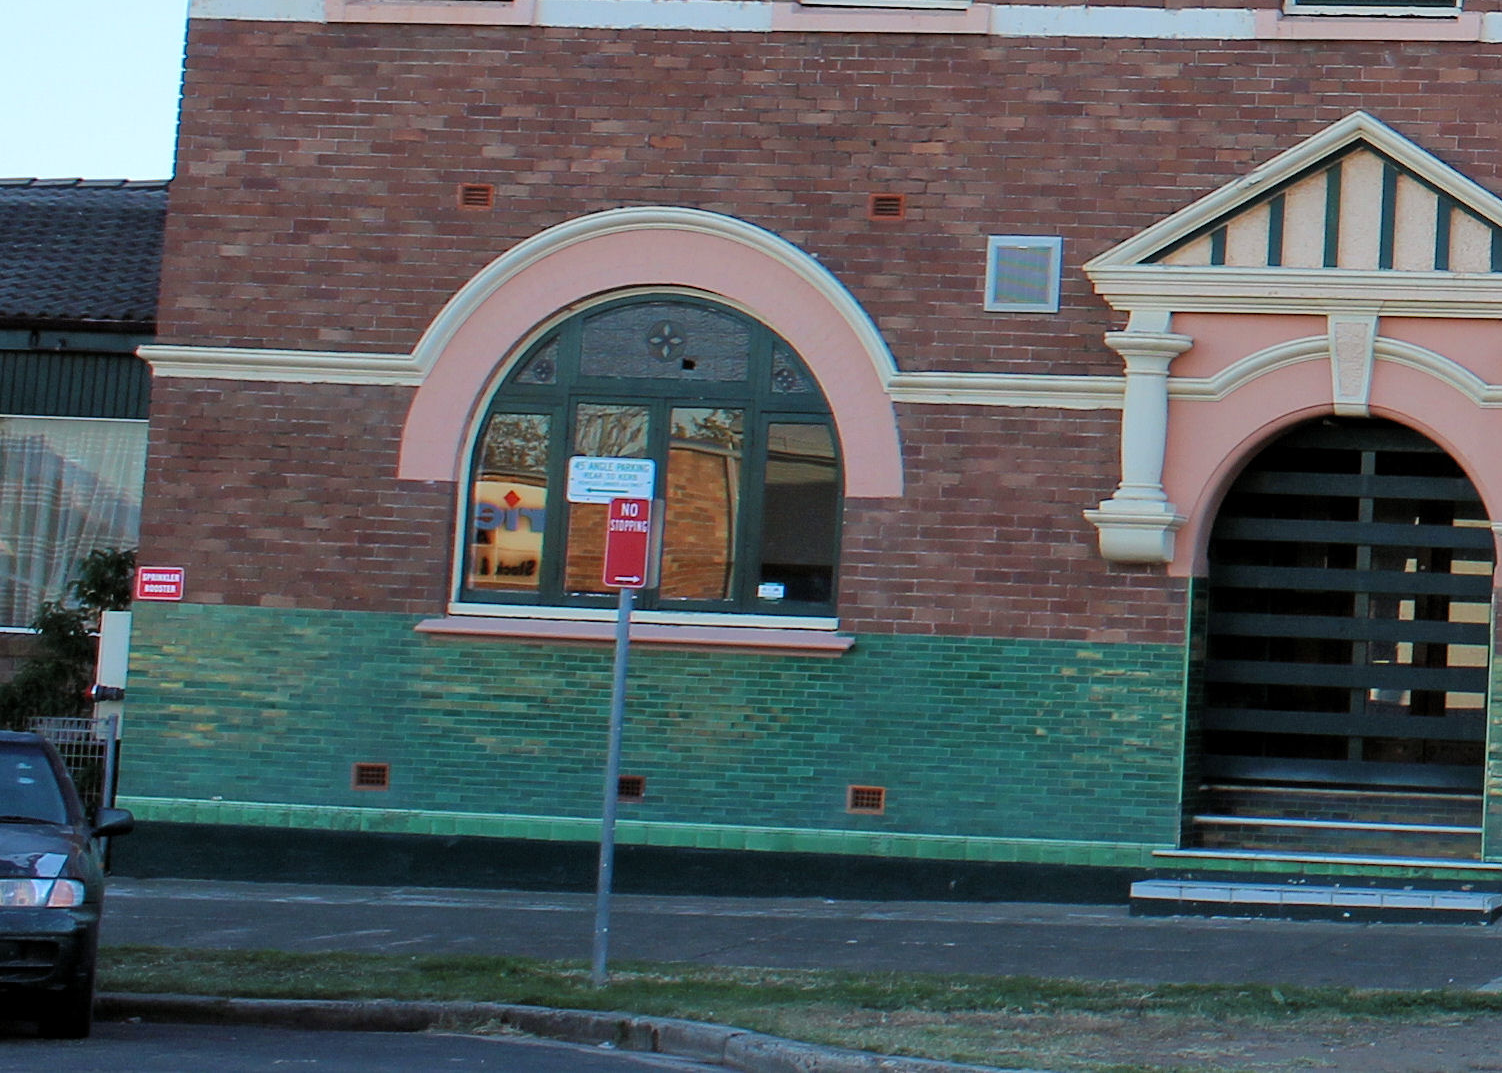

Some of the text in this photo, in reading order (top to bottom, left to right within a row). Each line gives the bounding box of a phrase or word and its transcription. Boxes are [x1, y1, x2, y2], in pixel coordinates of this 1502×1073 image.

[588, 461, 614, 472] ANGLE
[616, 463, 650, 473] PARKING
[621, 503, 639, 517] NO
[610, 519, 649, 533] STOPPING
